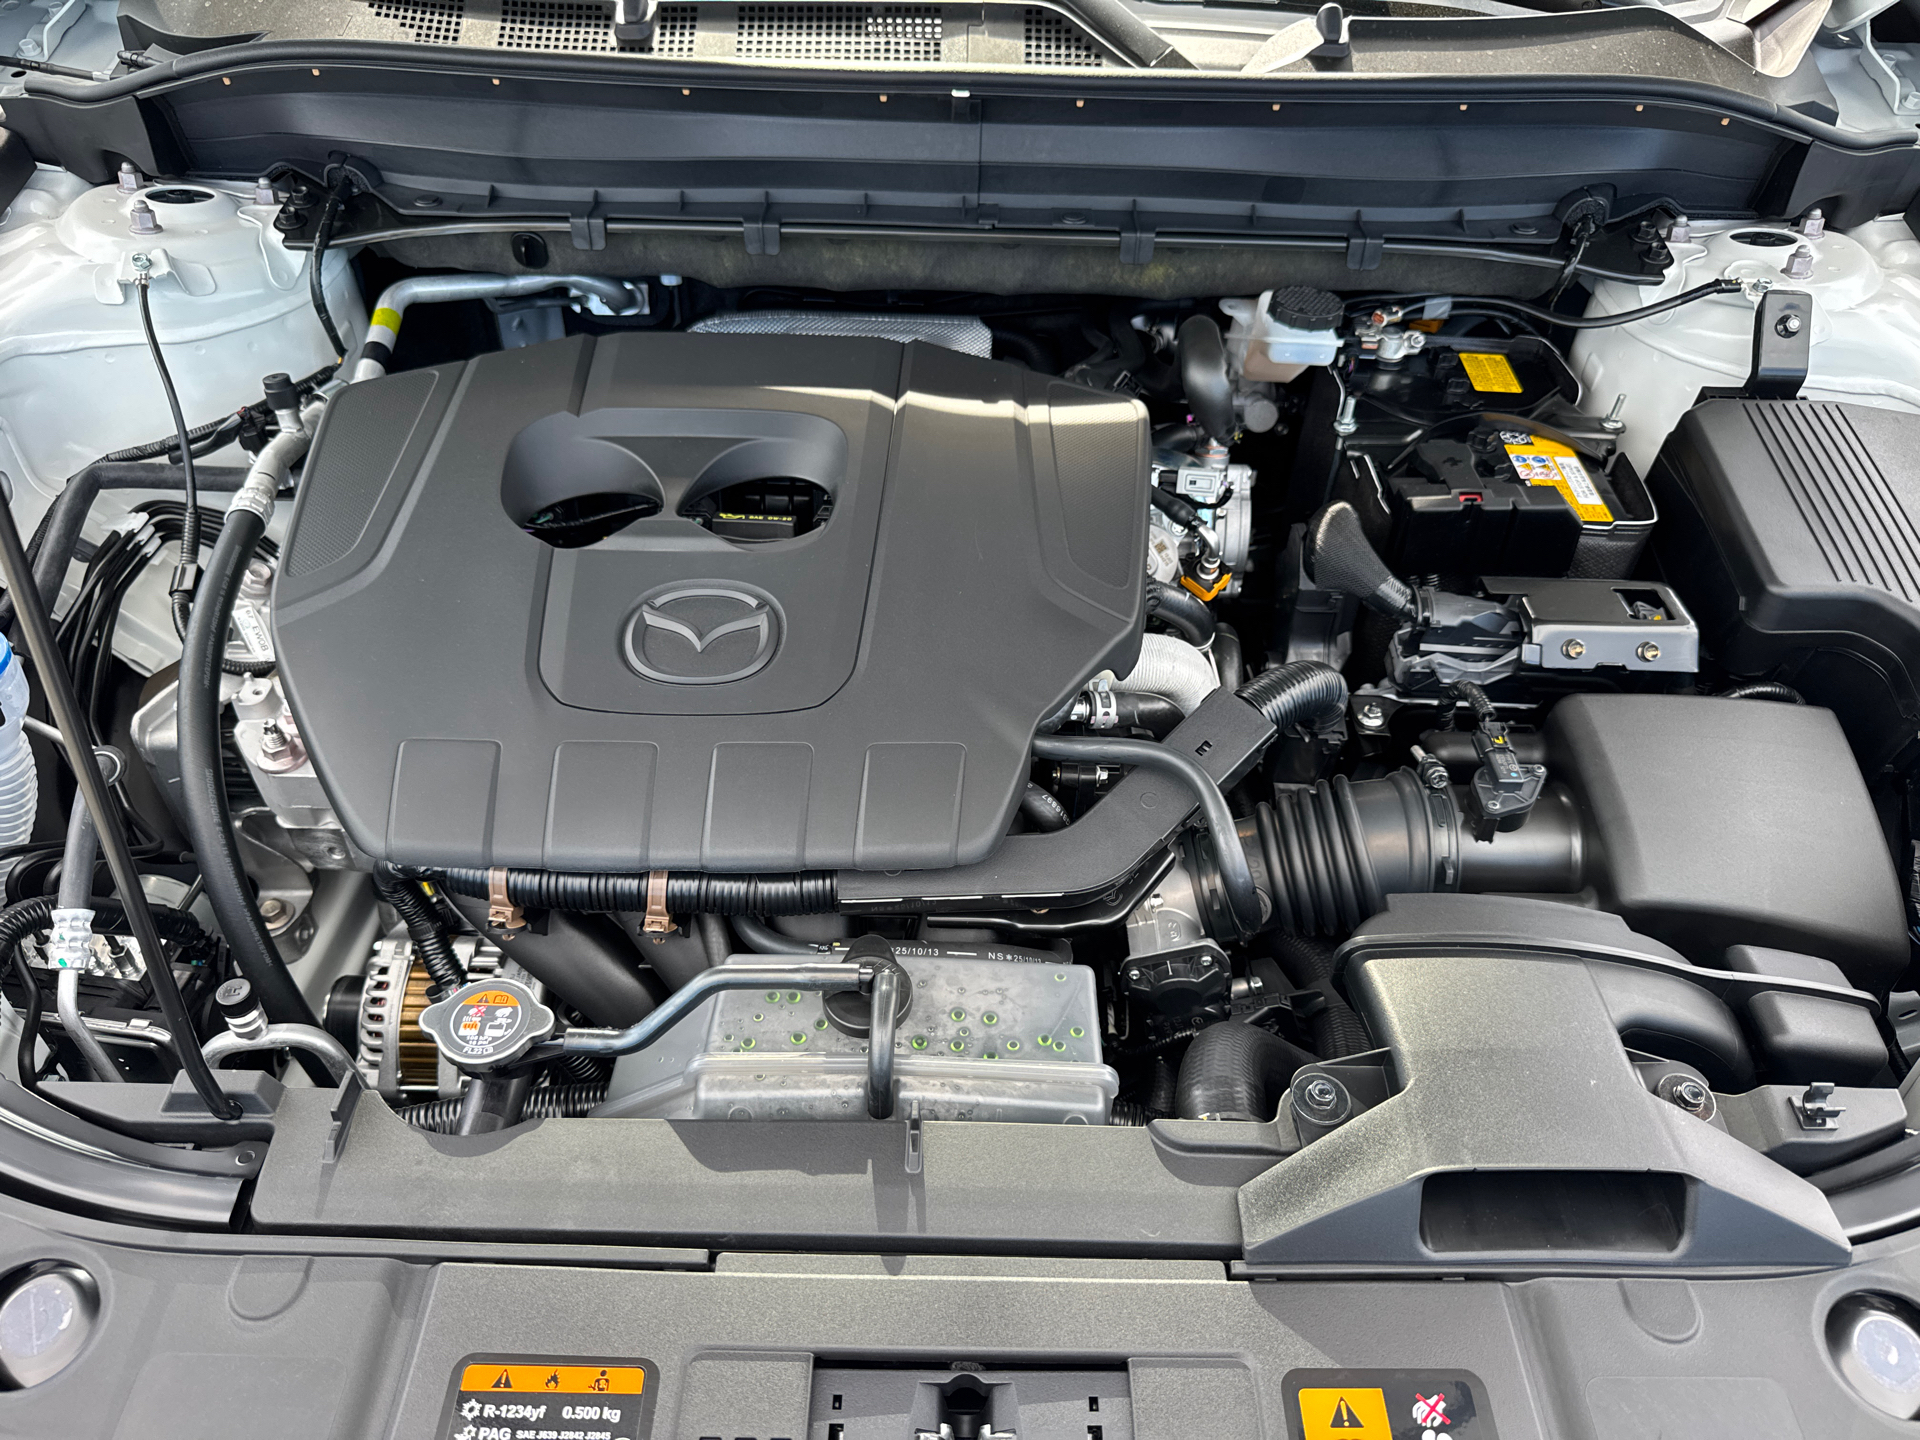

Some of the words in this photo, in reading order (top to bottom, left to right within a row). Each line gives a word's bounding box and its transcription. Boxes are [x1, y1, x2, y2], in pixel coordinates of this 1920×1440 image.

[482, 1404, 547, 1422] R-1234yf
[562, 1406, 600, 1420] 0.500
[602, 1406, 621, 1423] kg
[478, 1427, 512, 1440] PAG
[515, 1430, 536, 1440] SAE
[536, 1430, 558, 1440] J639
